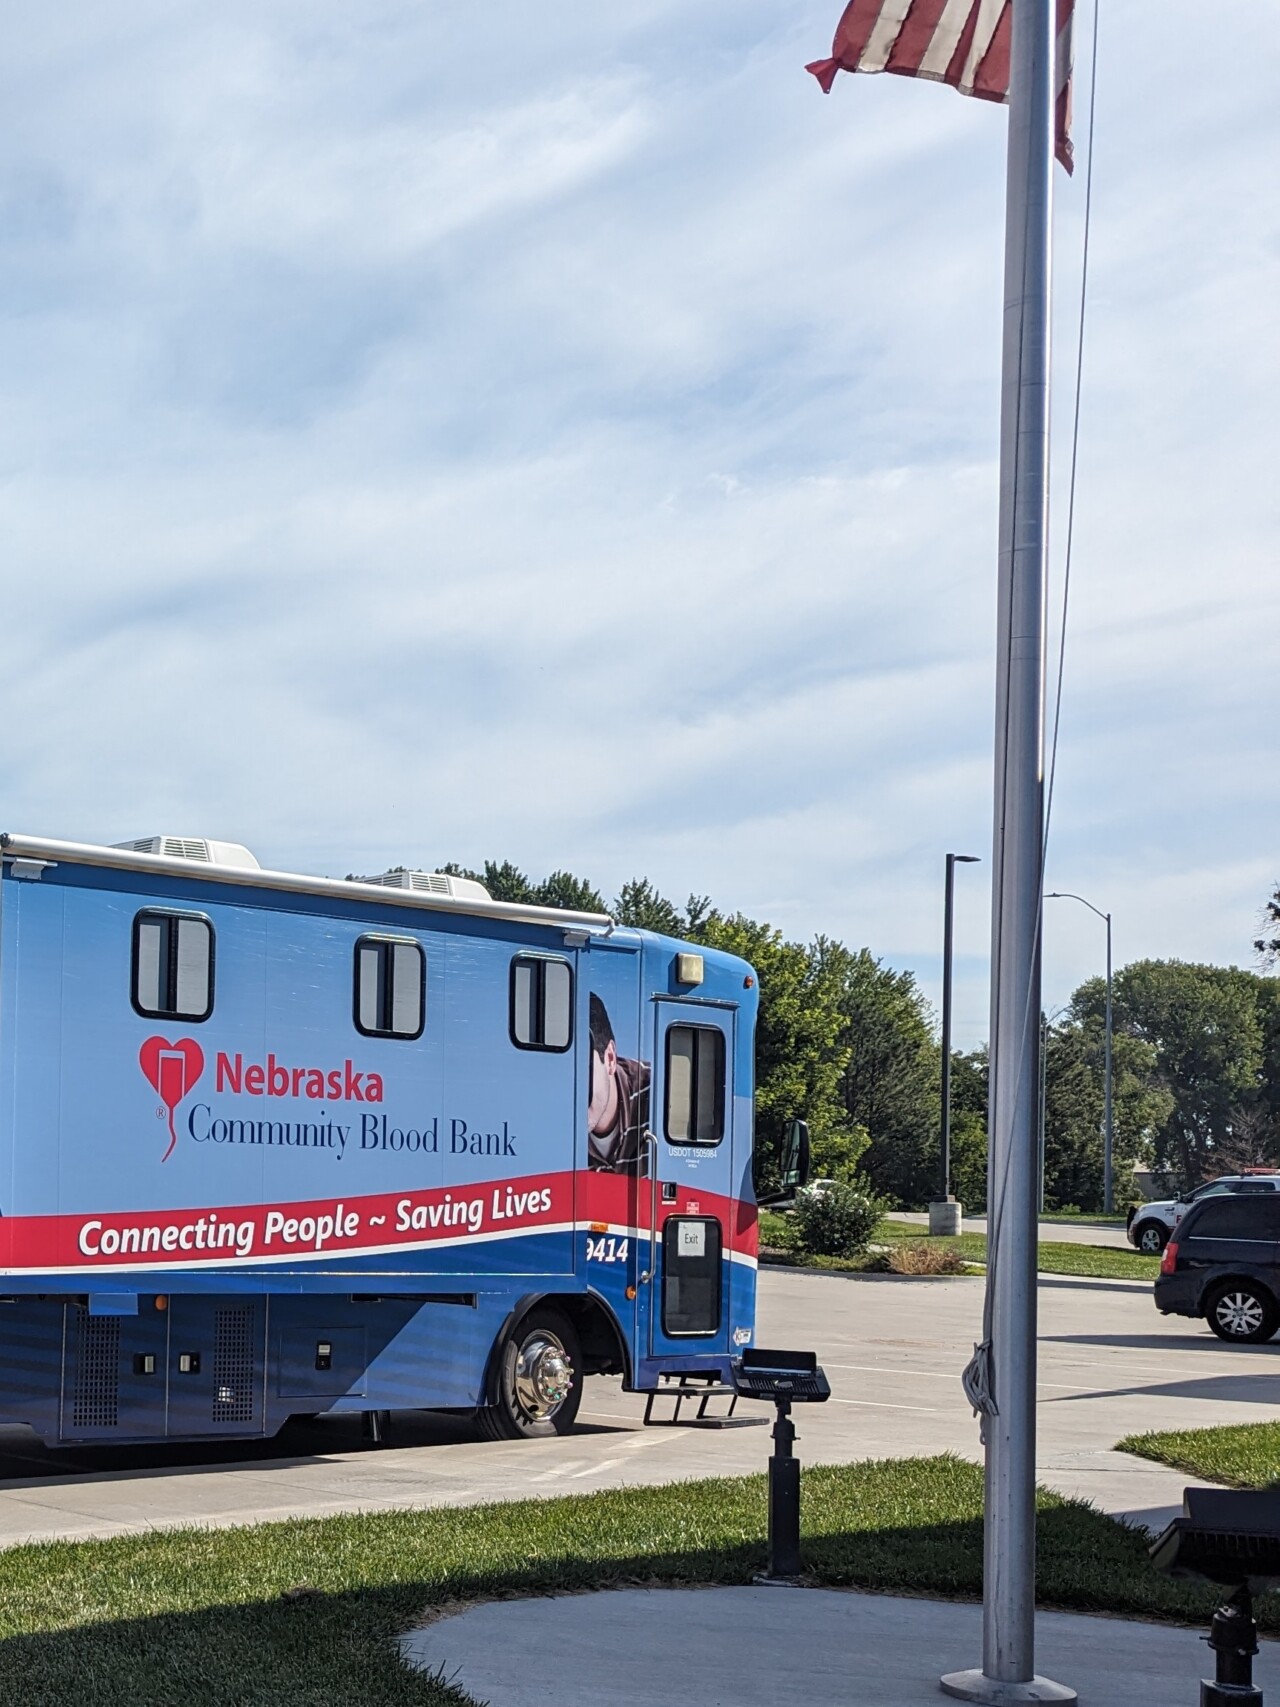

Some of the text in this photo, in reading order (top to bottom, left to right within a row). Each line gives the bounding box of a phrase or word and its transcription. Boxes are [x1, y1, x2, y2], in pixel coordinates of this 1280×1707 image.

[216, 1051, 383, 1103] Nebraska
[188, 1103, 518, 1160] Community Blood Bank
[79, 1213, 254, 1256] Connecting
[263, 1204, 360, 1249] People
[395, 1194, 485, 1234] Saving
[491, 1186, 553, 1221] Lives
[684, 1233, 699, 1245] Exit
[586, 1237, 629, 1262] 9414
